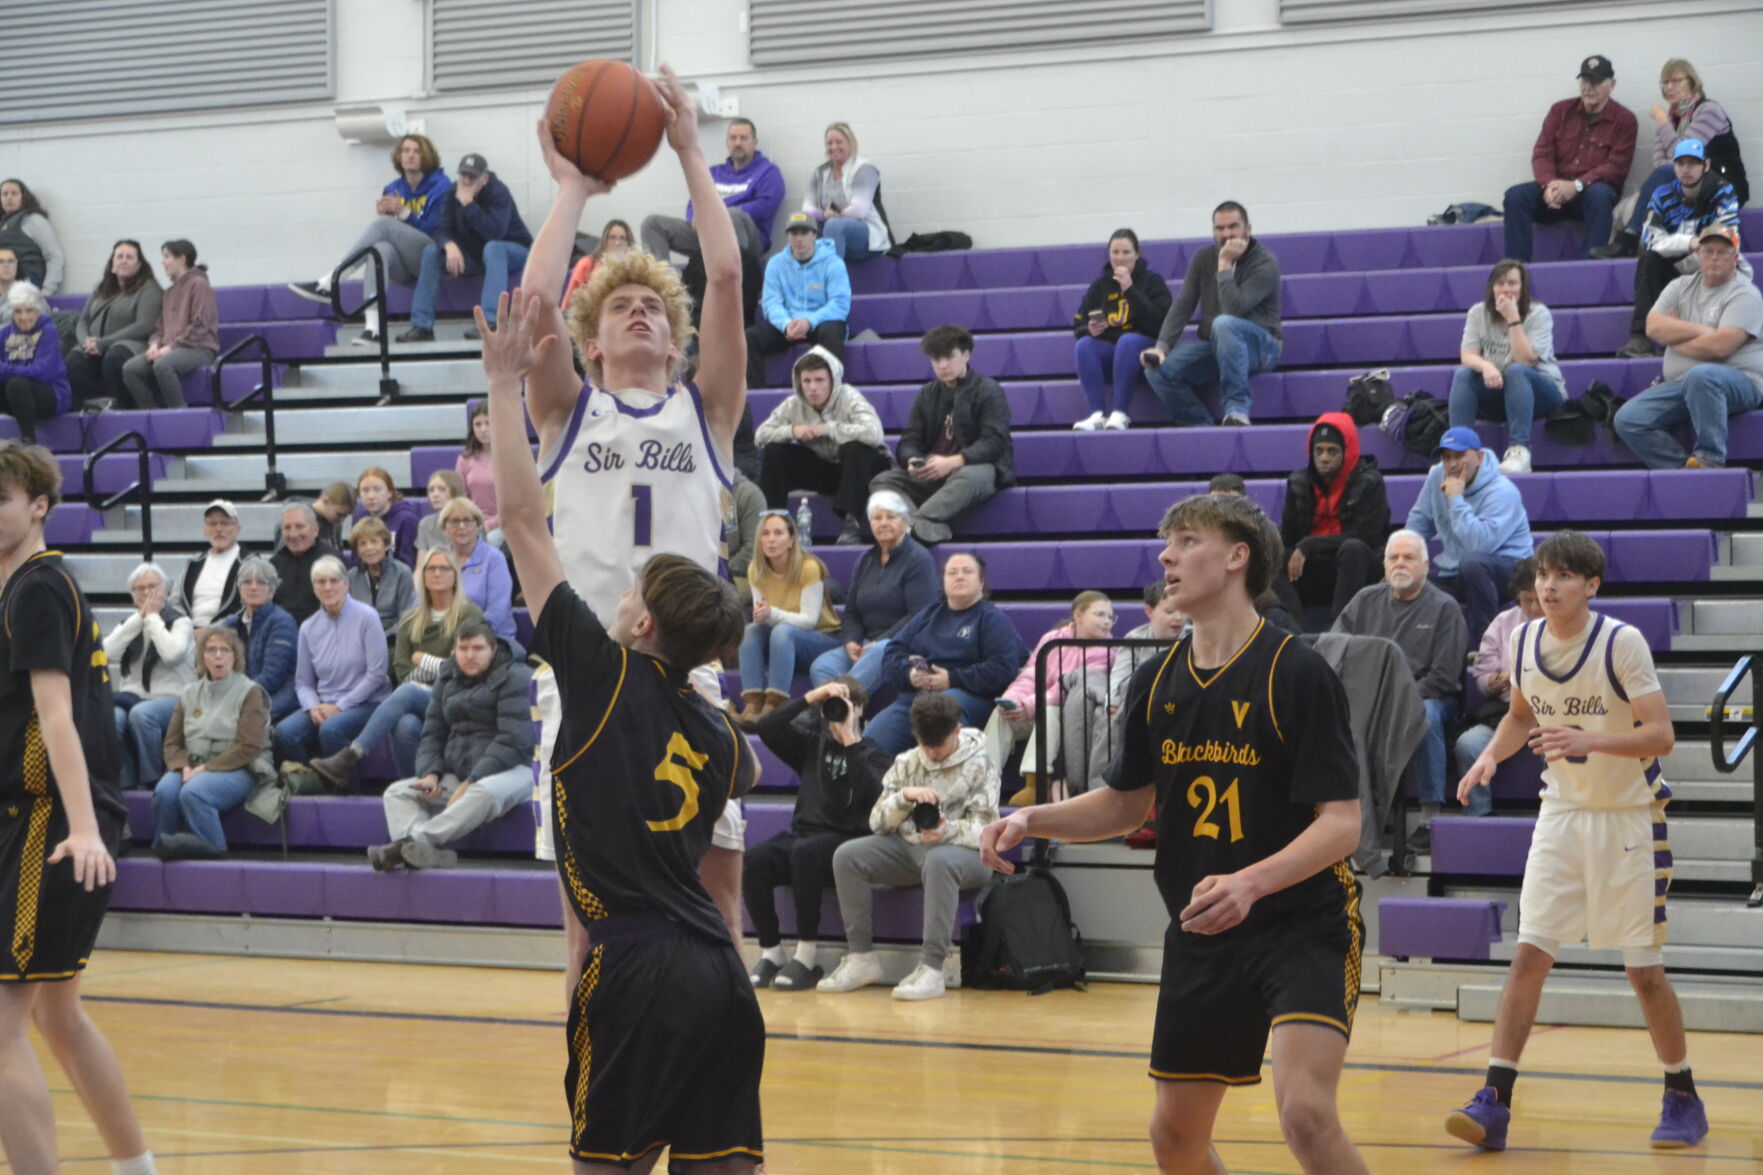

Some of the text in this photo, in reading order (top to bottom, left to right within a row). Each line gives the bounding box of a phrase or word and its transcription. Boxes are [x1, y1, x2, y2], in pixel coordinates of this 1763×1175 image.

[584, 439, 697, 473] Sir Bills
[630, 484, 653, 548] 1
[1231, 700, 1251, 729] V
[1531, 695, 1609, 716] Sir Bills
[1161, 738, 1261, 766] Blackbirds
[645, 731, 709, 832] 5
[1186, 775, 1245, 843] 21
